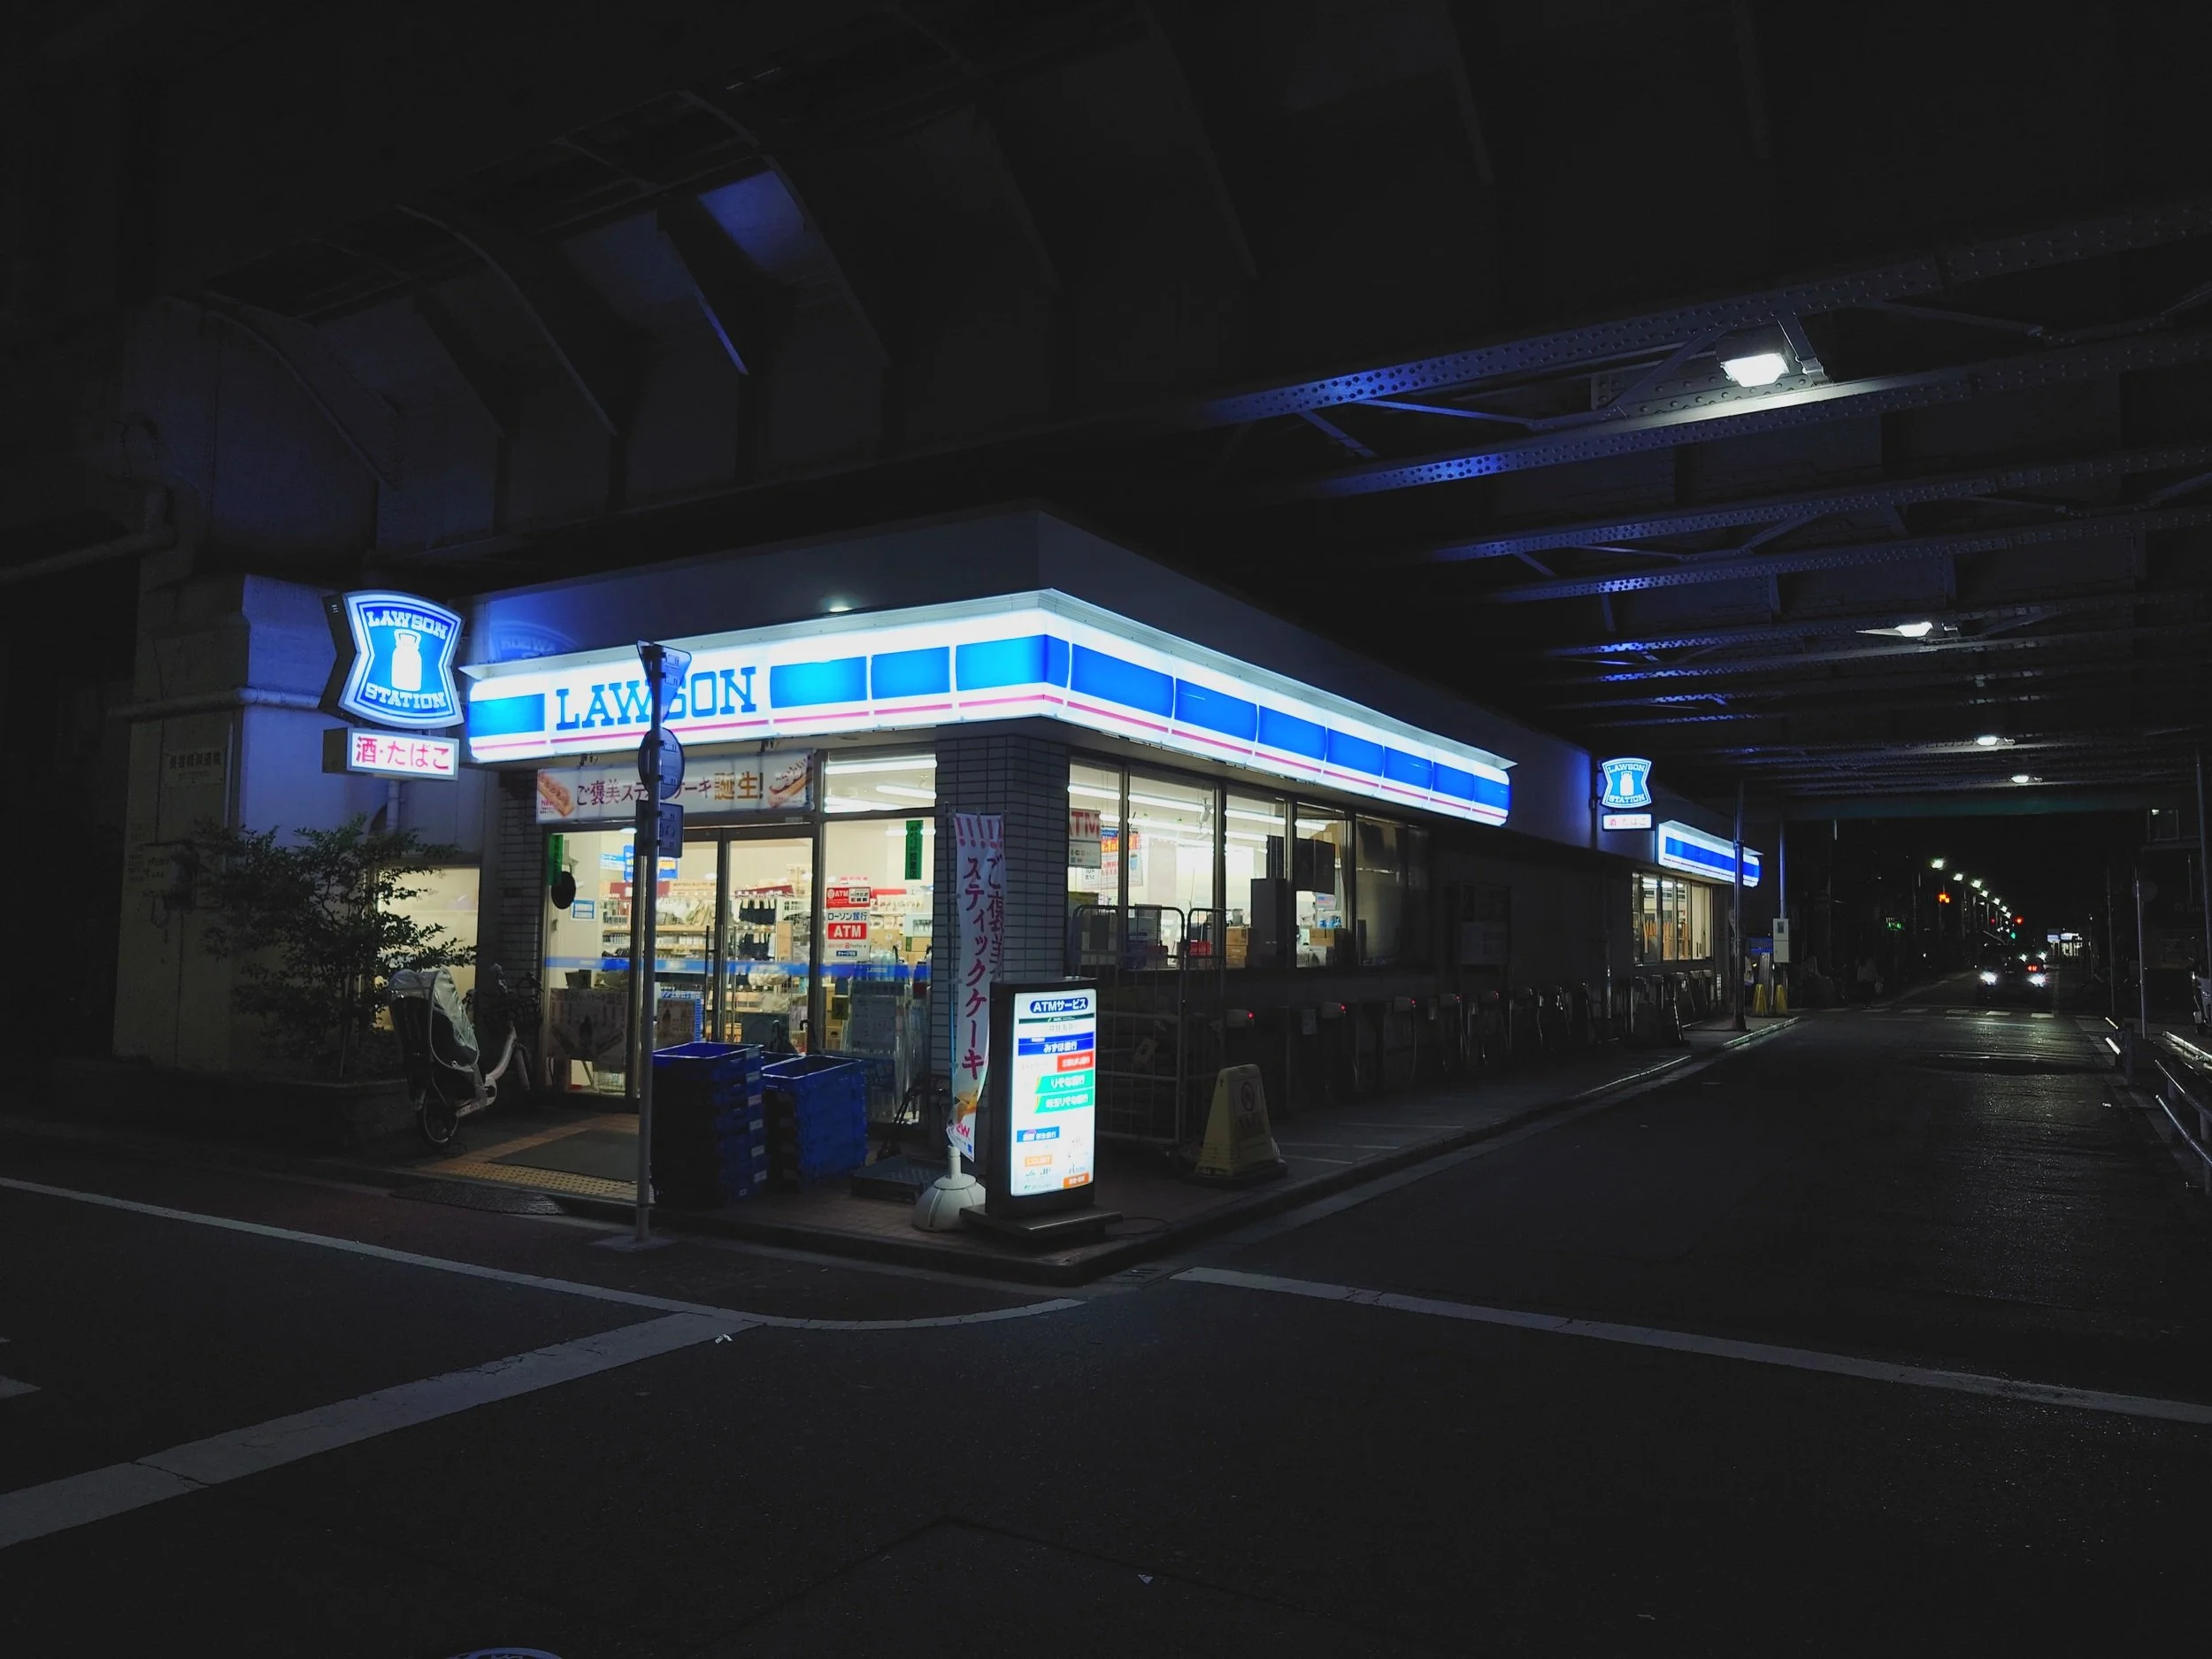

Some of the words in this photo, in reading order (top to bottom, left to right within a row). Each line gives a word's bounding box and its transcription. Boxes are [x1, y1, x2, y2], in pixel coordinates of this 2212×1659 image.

[366, 611, 449, 640] LAWSON
[365, 682, 446, 710] STATION
[556, 666, 757, 731] LAWSON
[357, 736, 449, 771] 酒・たばこ
[1608, 763, 1645, 773] LAWSON
[1609, 794, 1646, 803] STATION
[828, 912, 867, 921] ローソン銀行
[834, 925, 862, 938] ATM
[961, 857, 987, 1079] スティックケーキ
[1033, 998, 1087, 1012] ATMサービス
